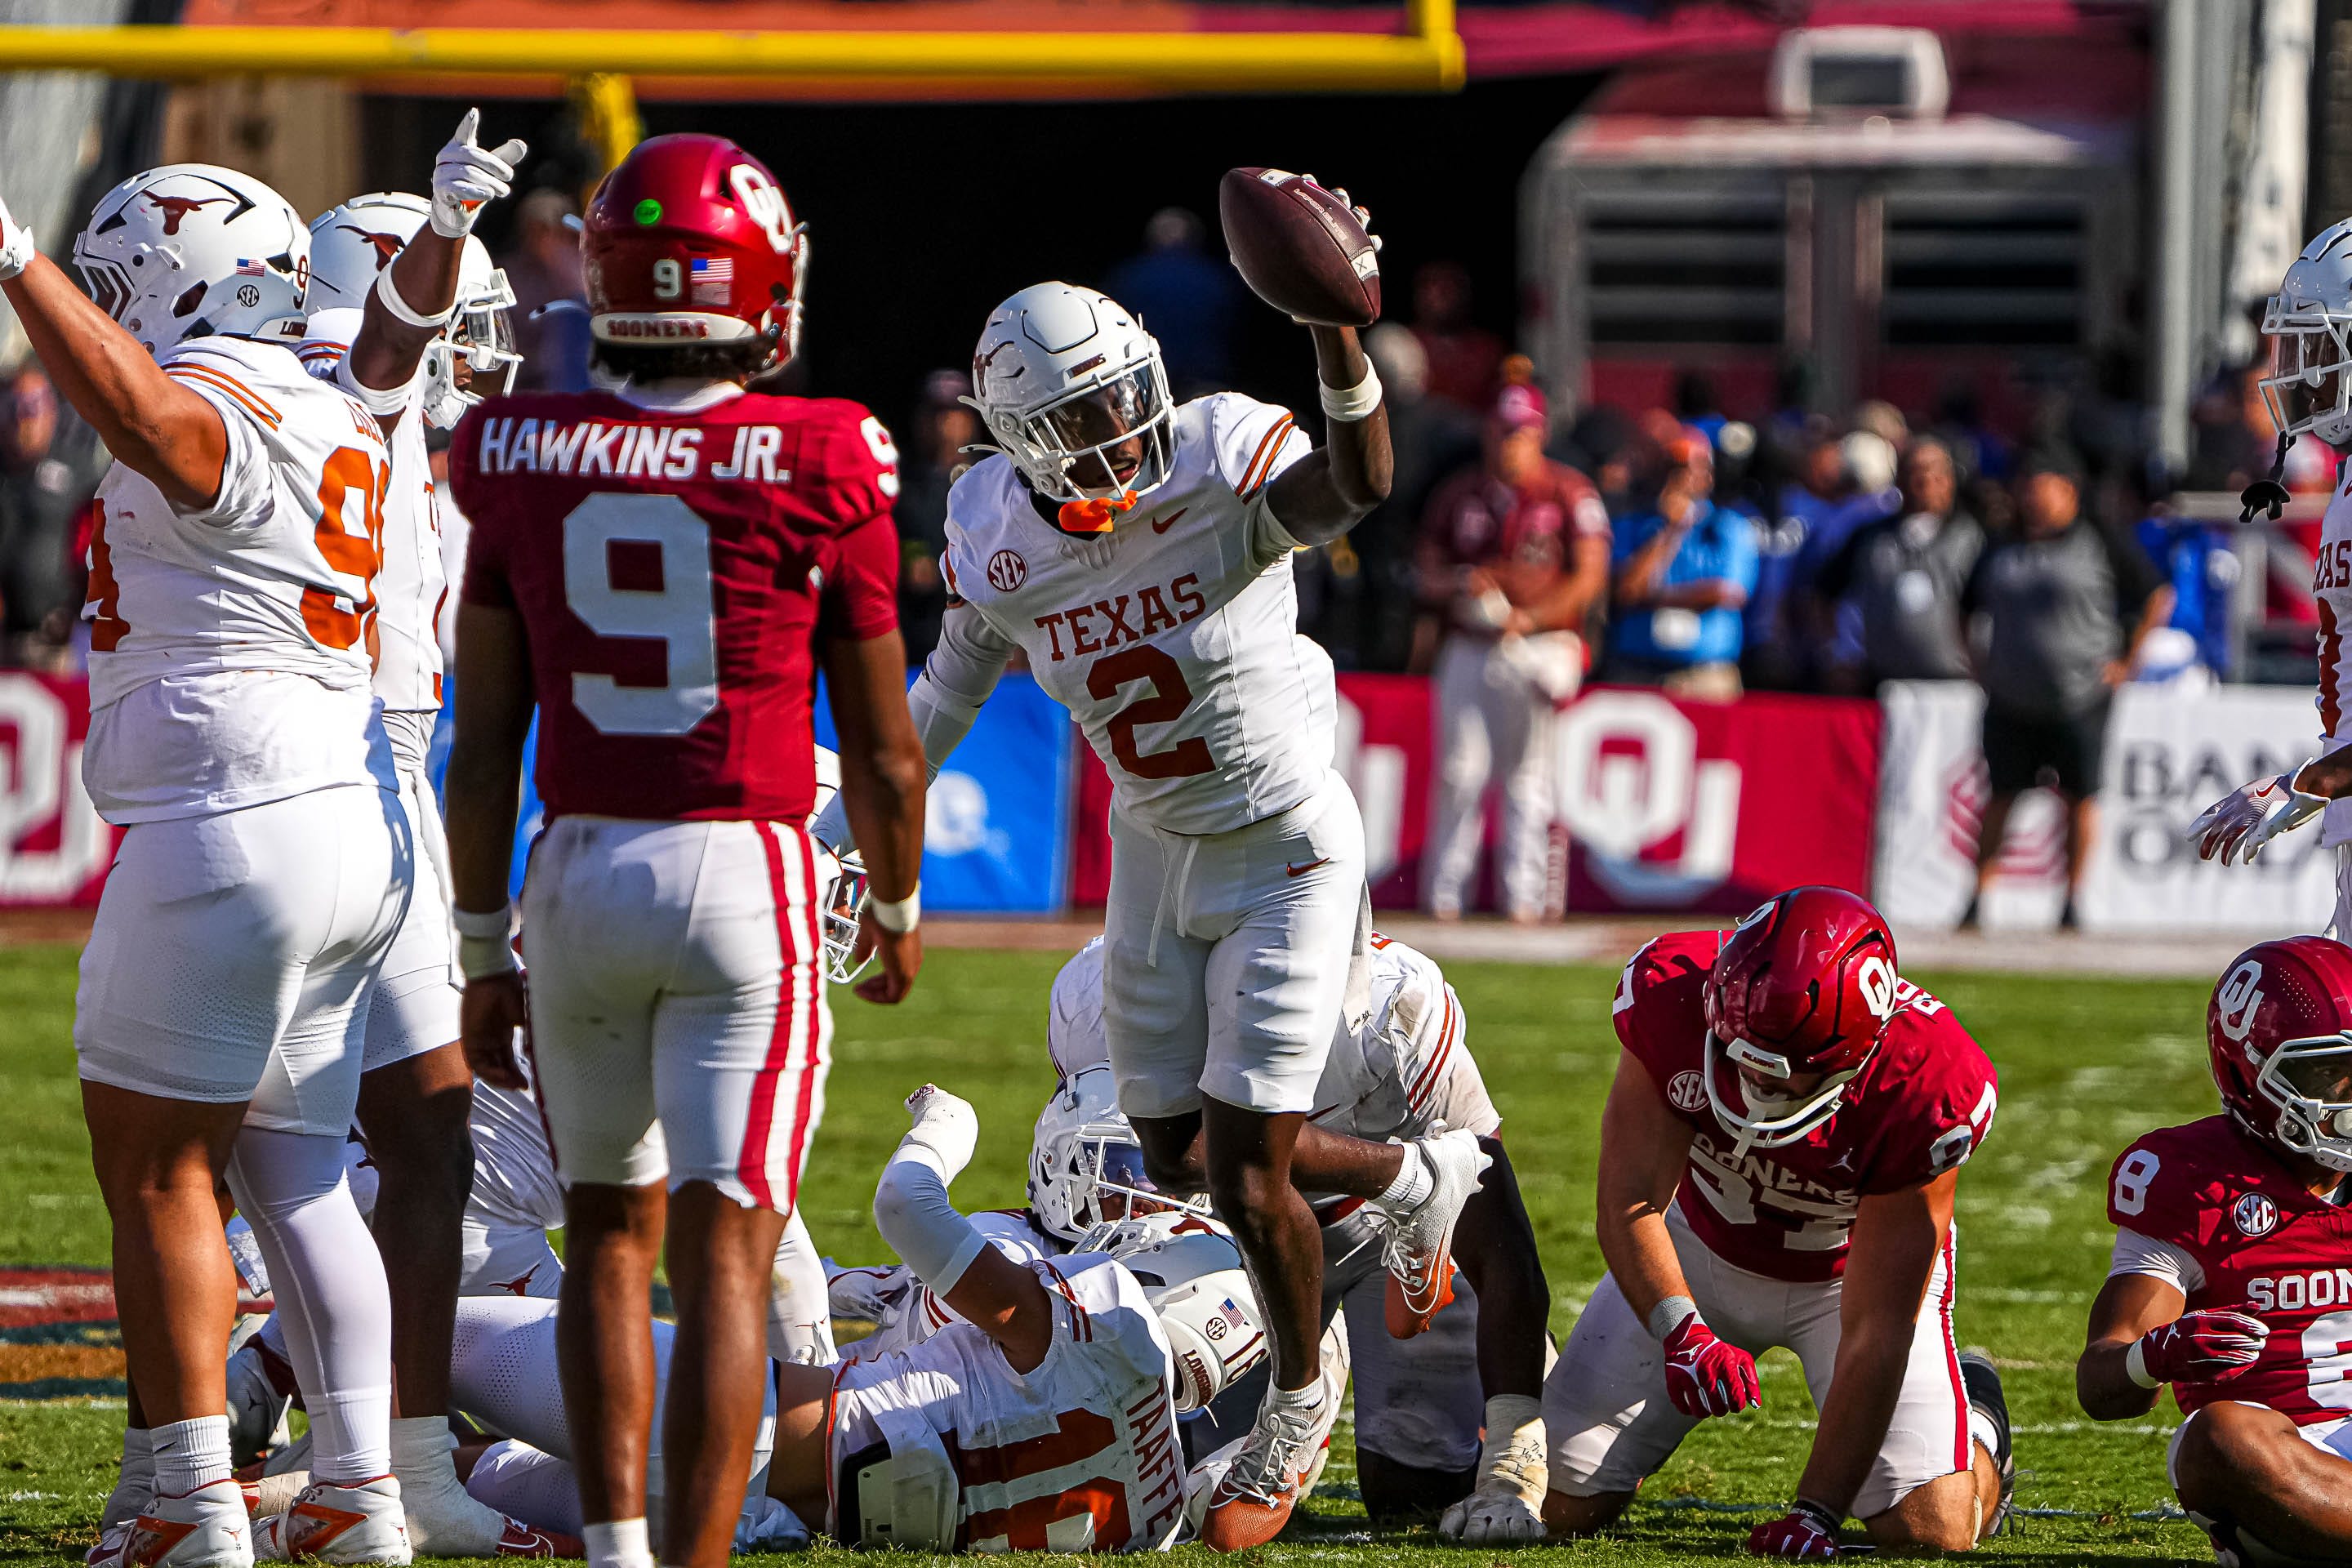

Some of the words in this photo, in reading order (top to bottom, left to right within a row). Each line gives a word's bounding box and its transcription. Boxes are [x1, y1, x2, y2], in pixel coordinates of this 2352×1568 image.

[237, 285, 260, 307] SEC
[653, 258, 683, 298] 9
[607, 318, 708, 337] SOONERS
[479, 416, 705, 480] HAWKINS
[710, 425, 792, 484] JR.
[859, 415, 901, 498] 9
[988, 550, 1027, 591] SEC
[562, 492, 719, 737] 9
[1034, 572, 1207, 662] TEXAS
[1085, 644, 1216, 780] 2
[1554, 688, 1743, 906] OU
[2218, 960, 2265, 1041] OU
[2115, 1149, 2160, 1216] 8
[2238, 1194, 2274, 1235] SEC
[1206, 1316, 1227, 1340] SEC
[1125, 1374, 1184, 1537] TAAFFE
